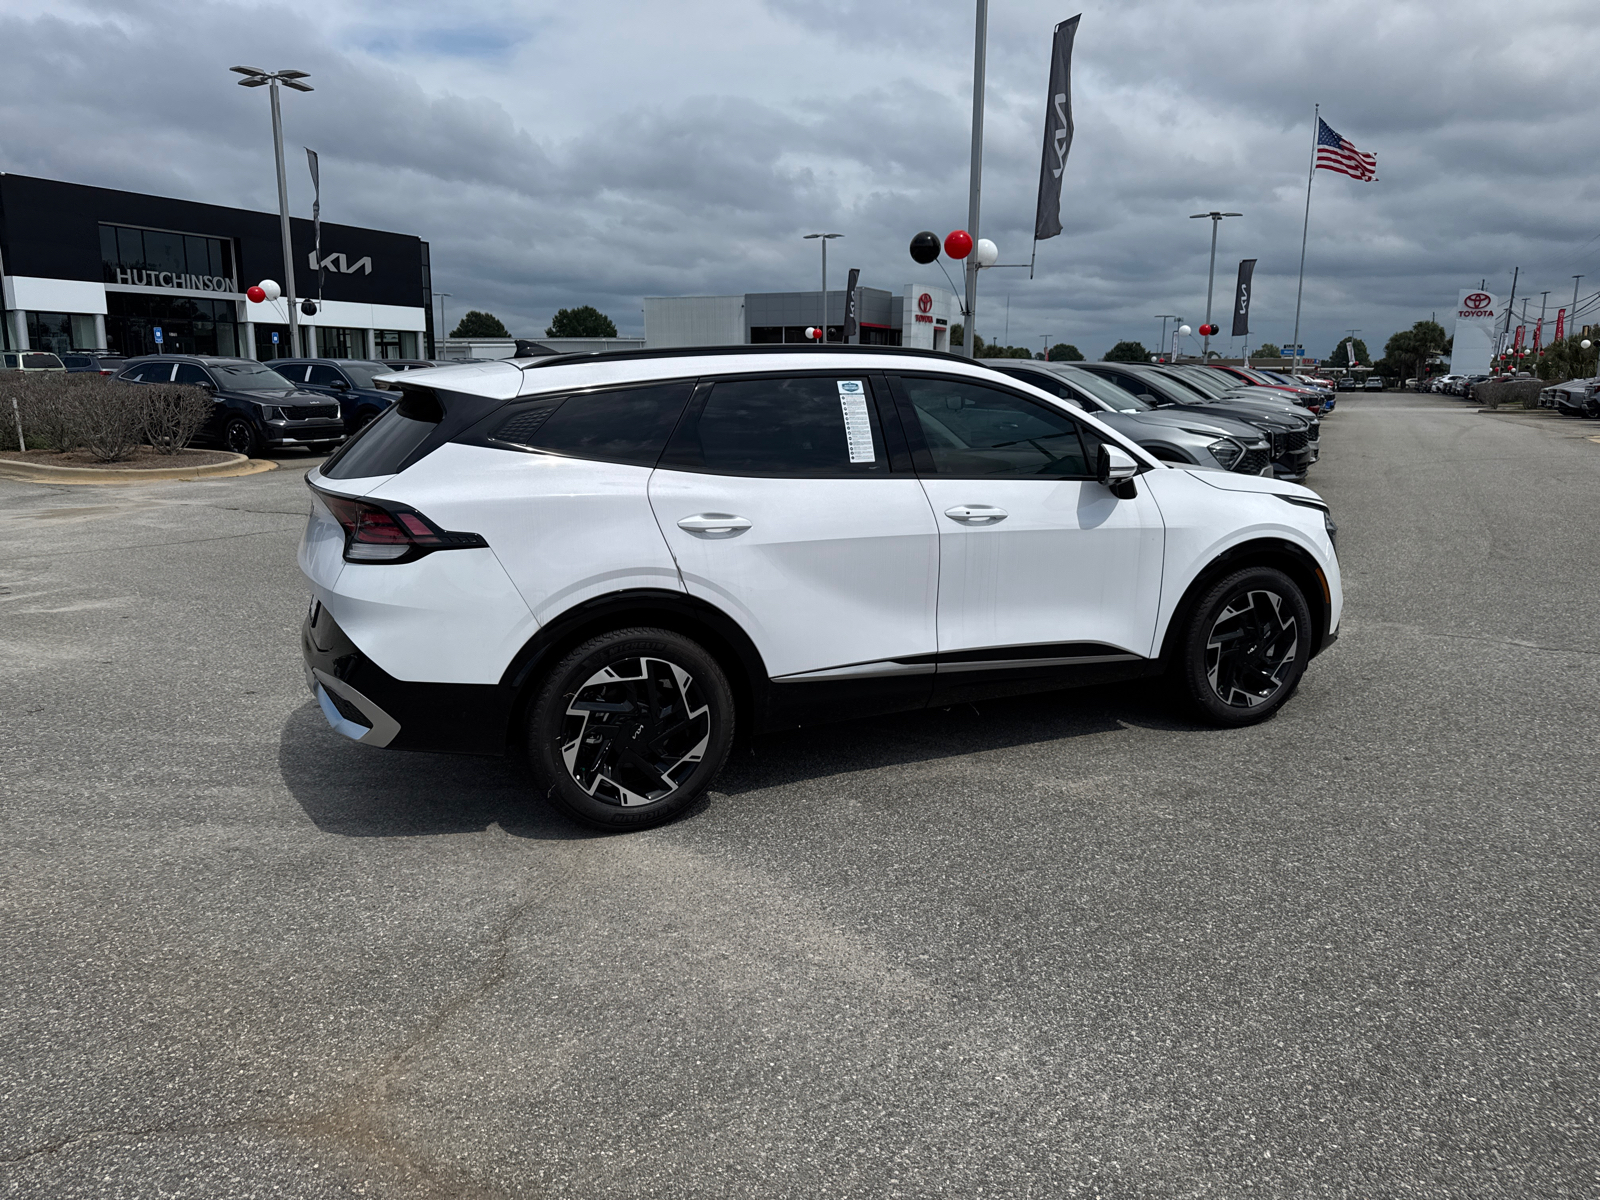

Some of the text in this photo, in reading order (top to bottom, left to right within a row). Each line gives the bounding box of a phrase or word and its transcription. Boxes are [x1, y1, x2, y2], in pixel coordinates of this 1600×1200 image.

[308, 250, 372, 276] KIA
[116, 268, 238, 293] HUTCHINSON
[1458, 310, 1494, 318] TOYOTA
[608, 641, 666, 656] MICHELIN
